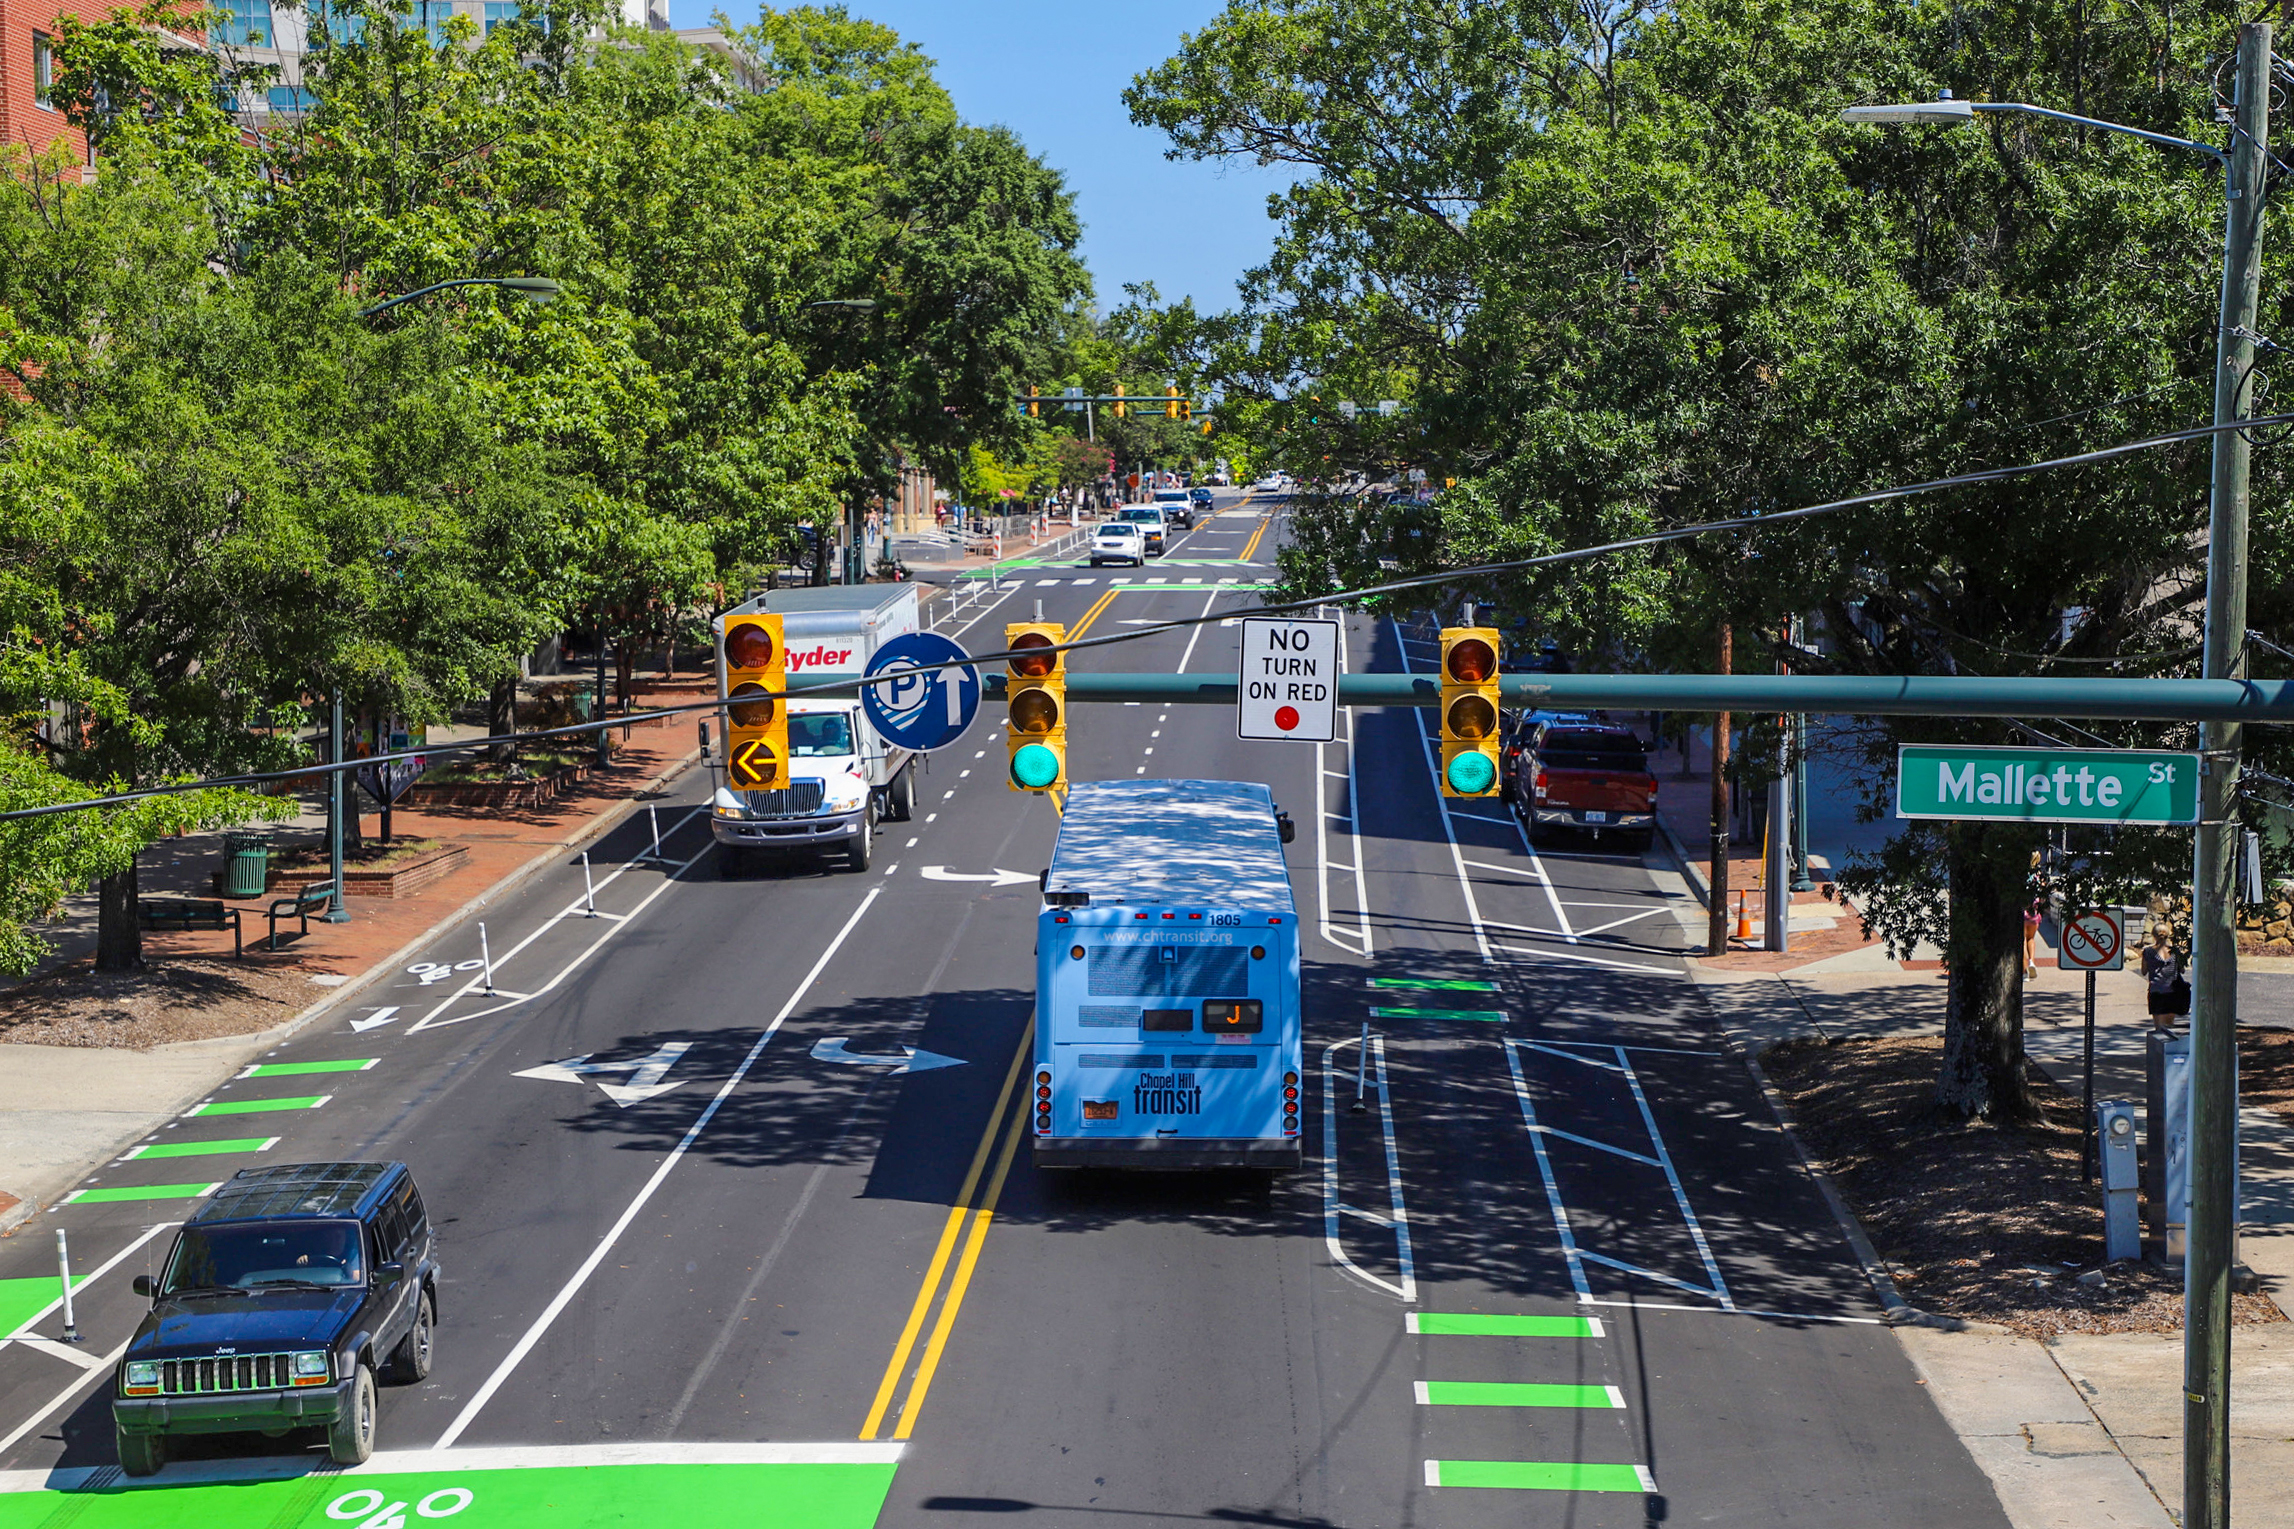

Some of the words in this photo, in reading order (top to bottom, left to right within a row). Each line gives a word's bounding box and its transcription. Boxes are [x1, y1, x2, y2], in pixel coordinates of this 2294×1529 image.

[1269, 628, 1310, 652] NO
[1262, 657, 1316, 677] TURN
[889, 668, 917, 705] P
[1249, 681, 1276, 700] ON
[1287, 683, 1327, 702] RED
[1938, 761, 2123, 807] Mallette
[2148, 761, 2176, 784] St
[1209, 914, 1241, 926] 1805
[1103, 930, 1233, 945] www.chtransit.org
[1226, 1005, 1240, 1024] J
[1140, 1073, 1175, 1091] Chapel
[1178, 1073, 1195, 1089] Hill
[1133, 1085, 1202, 1115] transit
[215, 1346, 236, 1355] Jeep
